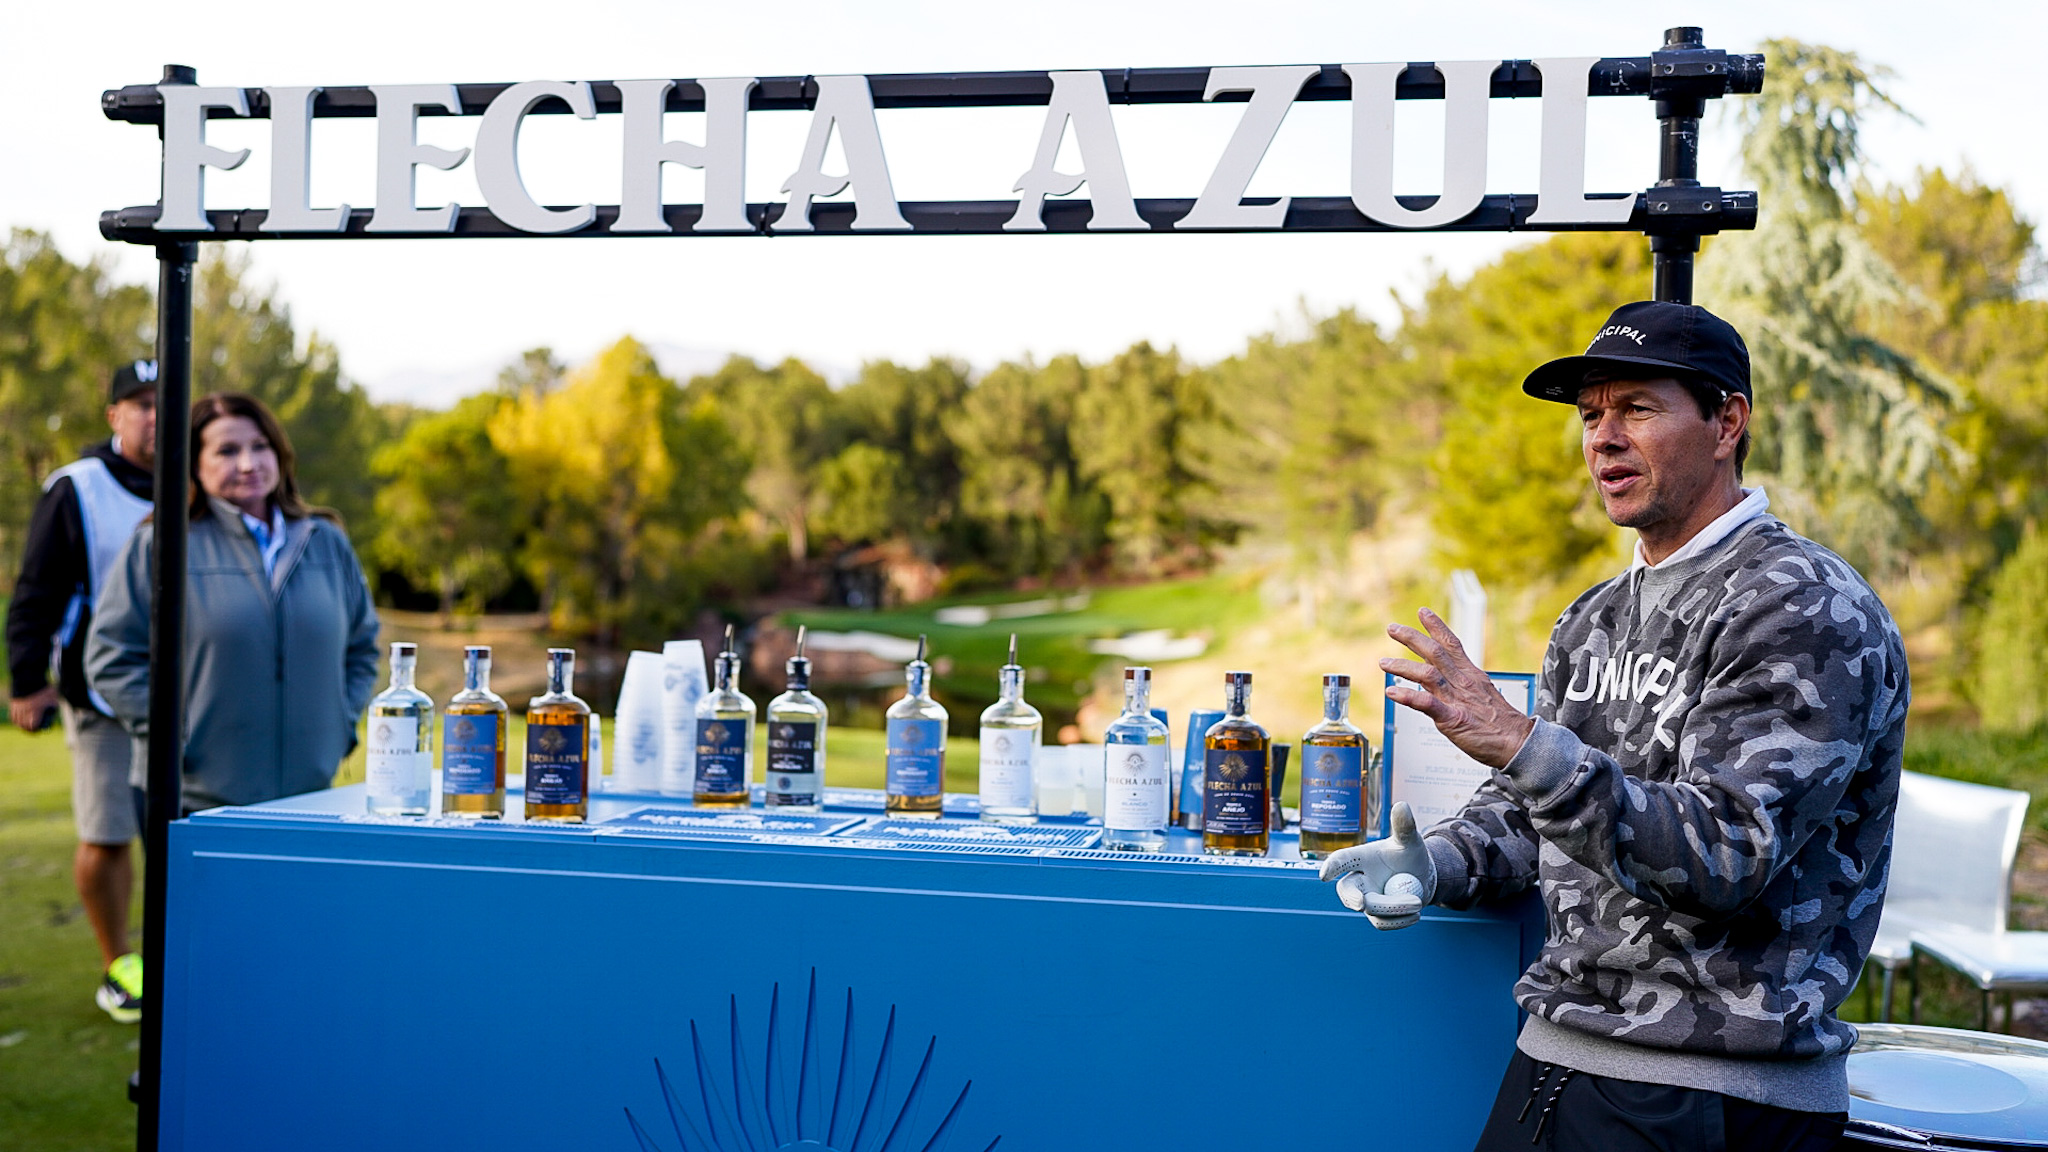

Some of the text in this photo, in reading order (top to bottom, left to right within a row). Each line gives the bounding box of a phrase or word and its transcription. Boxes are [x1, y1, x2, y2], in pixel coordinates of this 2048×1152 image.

[153, 56, 1639, 234] FLECHA AZUL
[1583, 325, 1647, 355] NICIPAL
[1141, 777, 1163, 786] AZUL
[1207, 781, 1262, 791] FLECHA AZUL
